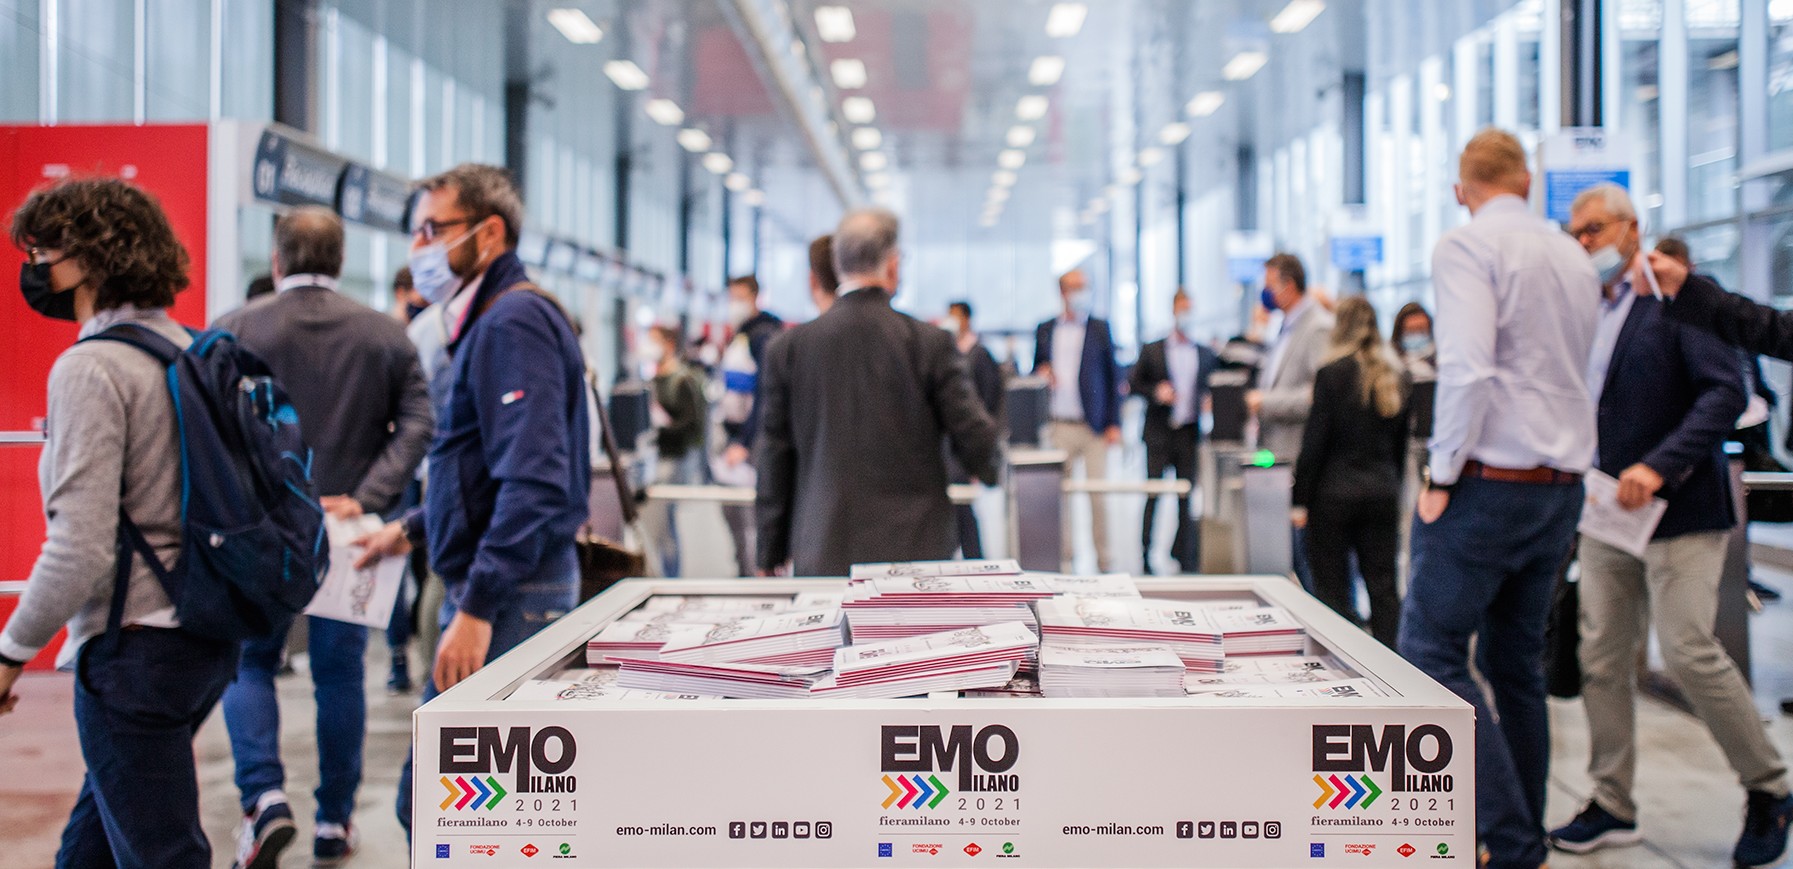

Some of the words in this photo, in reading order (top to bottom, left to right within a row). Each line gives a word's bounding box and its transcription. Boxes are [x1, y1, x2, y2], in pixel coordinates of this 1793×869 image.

[439, 726, 577, 793] EMO
[881, 724, 1019, 792] EMO
[1312, 724, 1453, 792] EMO
[516, 799, 577, 811] 2021
[958, 798, 1020, 811] 2021
[1391, 798, 1454, 811] 2021
[437, 817, 508, 827] fieramilano
[516, 819, 533, 827] 4-9
[538, 818, 577, 827] October
[879, 816, 950, 826] fieramilano
[958, 818, 976, 826] 4-9
[981, 817, 1020, 826] October
[1311, 816, 1383, 826] fieramilano
[1391, 818, 1409, 826] 4-9
[1414, 817, 1455, 826] October
[616, 823, 717, 836] emo-milan.com
[1062, 823, 1164, 835] emo-milan.com
